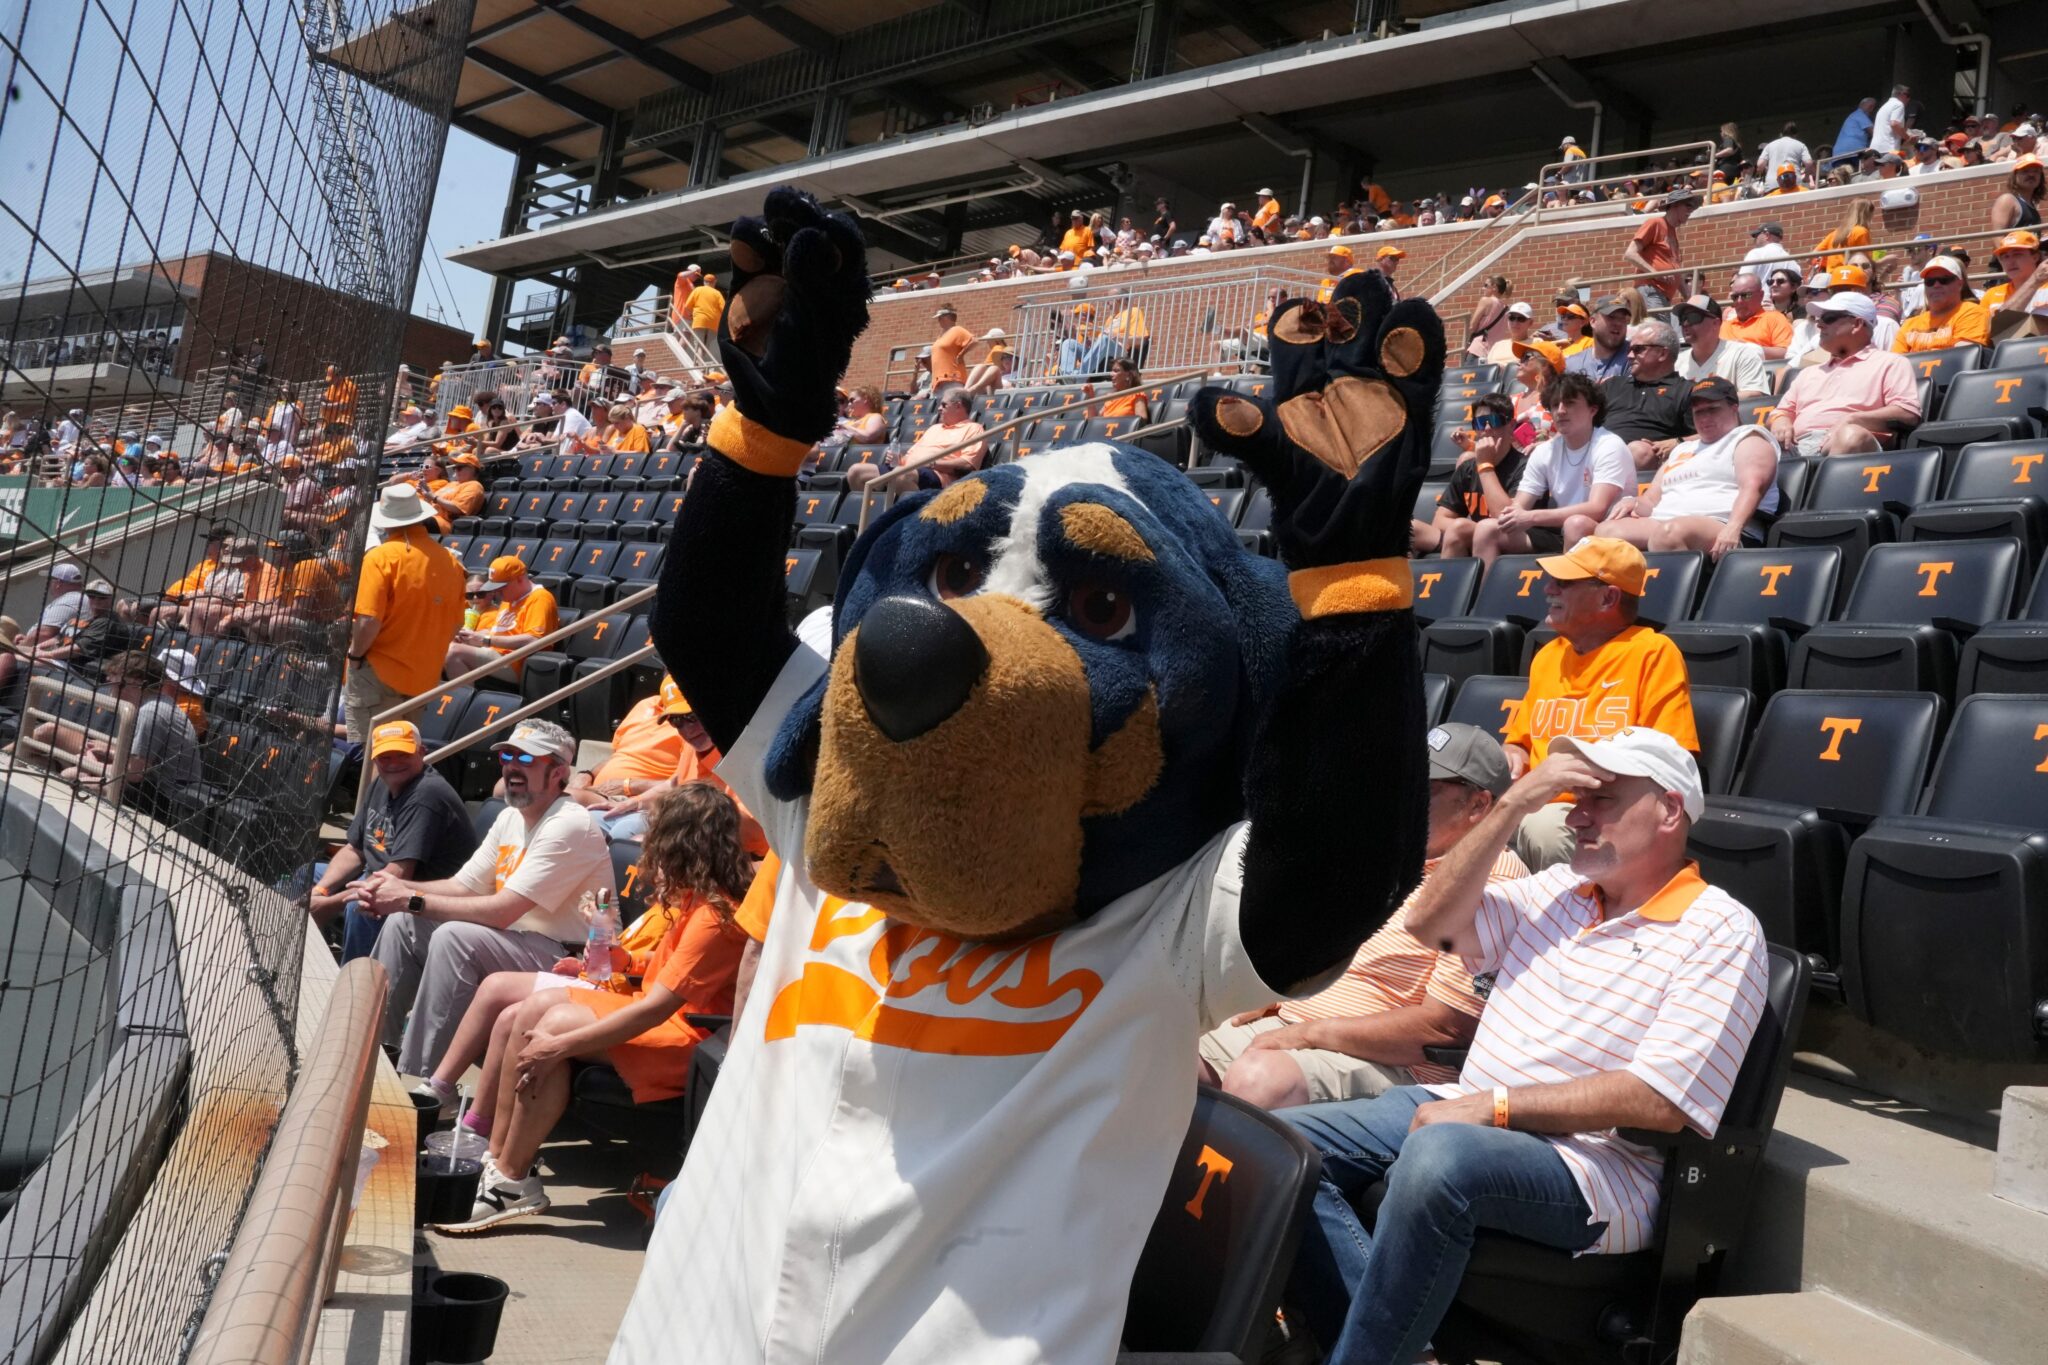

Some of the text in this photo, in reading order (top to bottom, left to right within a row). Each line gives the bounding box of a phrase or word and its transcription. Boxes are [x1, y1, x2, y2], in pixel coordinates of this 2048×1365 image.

[1840, 269, 1851, 280] T
[1919, 359, 1941, 377] T
[1461, 372, 1476, 384] T
[1151, 389, 1162, 400] T
[1252, 384, 1264, 396] T
[1994, 378, 2022, 403] T
[1024, 397, 1034, 408] T
[1063, 394, 1074, 406] T
[1753, 406, 1775, 426] T
[1003, 427, 1016, 440] T
[1054, 425, 1066, 438] T
[1105, 422, 1119, 437] T
[624, 458, 634, 470] T
[658, 457, 668, 470] T
[860, 451, 872, 464] T
[533, 460, 543, 471] T
[563, 460, 572, 471] T
[592, 460, 602, 471] T
[2011, 453, 2044, 483] T
[1862, 465, 1891, 492] T
[498, 497, 509, 510] T
[530, 497, 540, 510] T
[563, 499, 573, 511] T
[597, 499, 608, 512] T
[633, 499, 644, 512] T
[806, 499, 819, 515] T
[480, 543, 490, 557] T
[551, 547, 562, 561] T
[589, 549, 603, 564] T
[632, 551, 647, 566] T
[1419, 573, 1442, 598] T
[1517, 570, 1543, 597] T
[1760, 565, 1792, 597] T
[1917, 562, 1953, 597] T
[594, 620, 608, 641] T
[664, 684, 677, 700] T
[438, 694, 453, 716] T
[484, 705, 501, 727] T
[1530, 697, 1630, 739] VOLS
[1819, 717, 1863, 762] T
[1186, 1144, 1234, 1218] T
[1688, 1166, 1699, 1184] B
